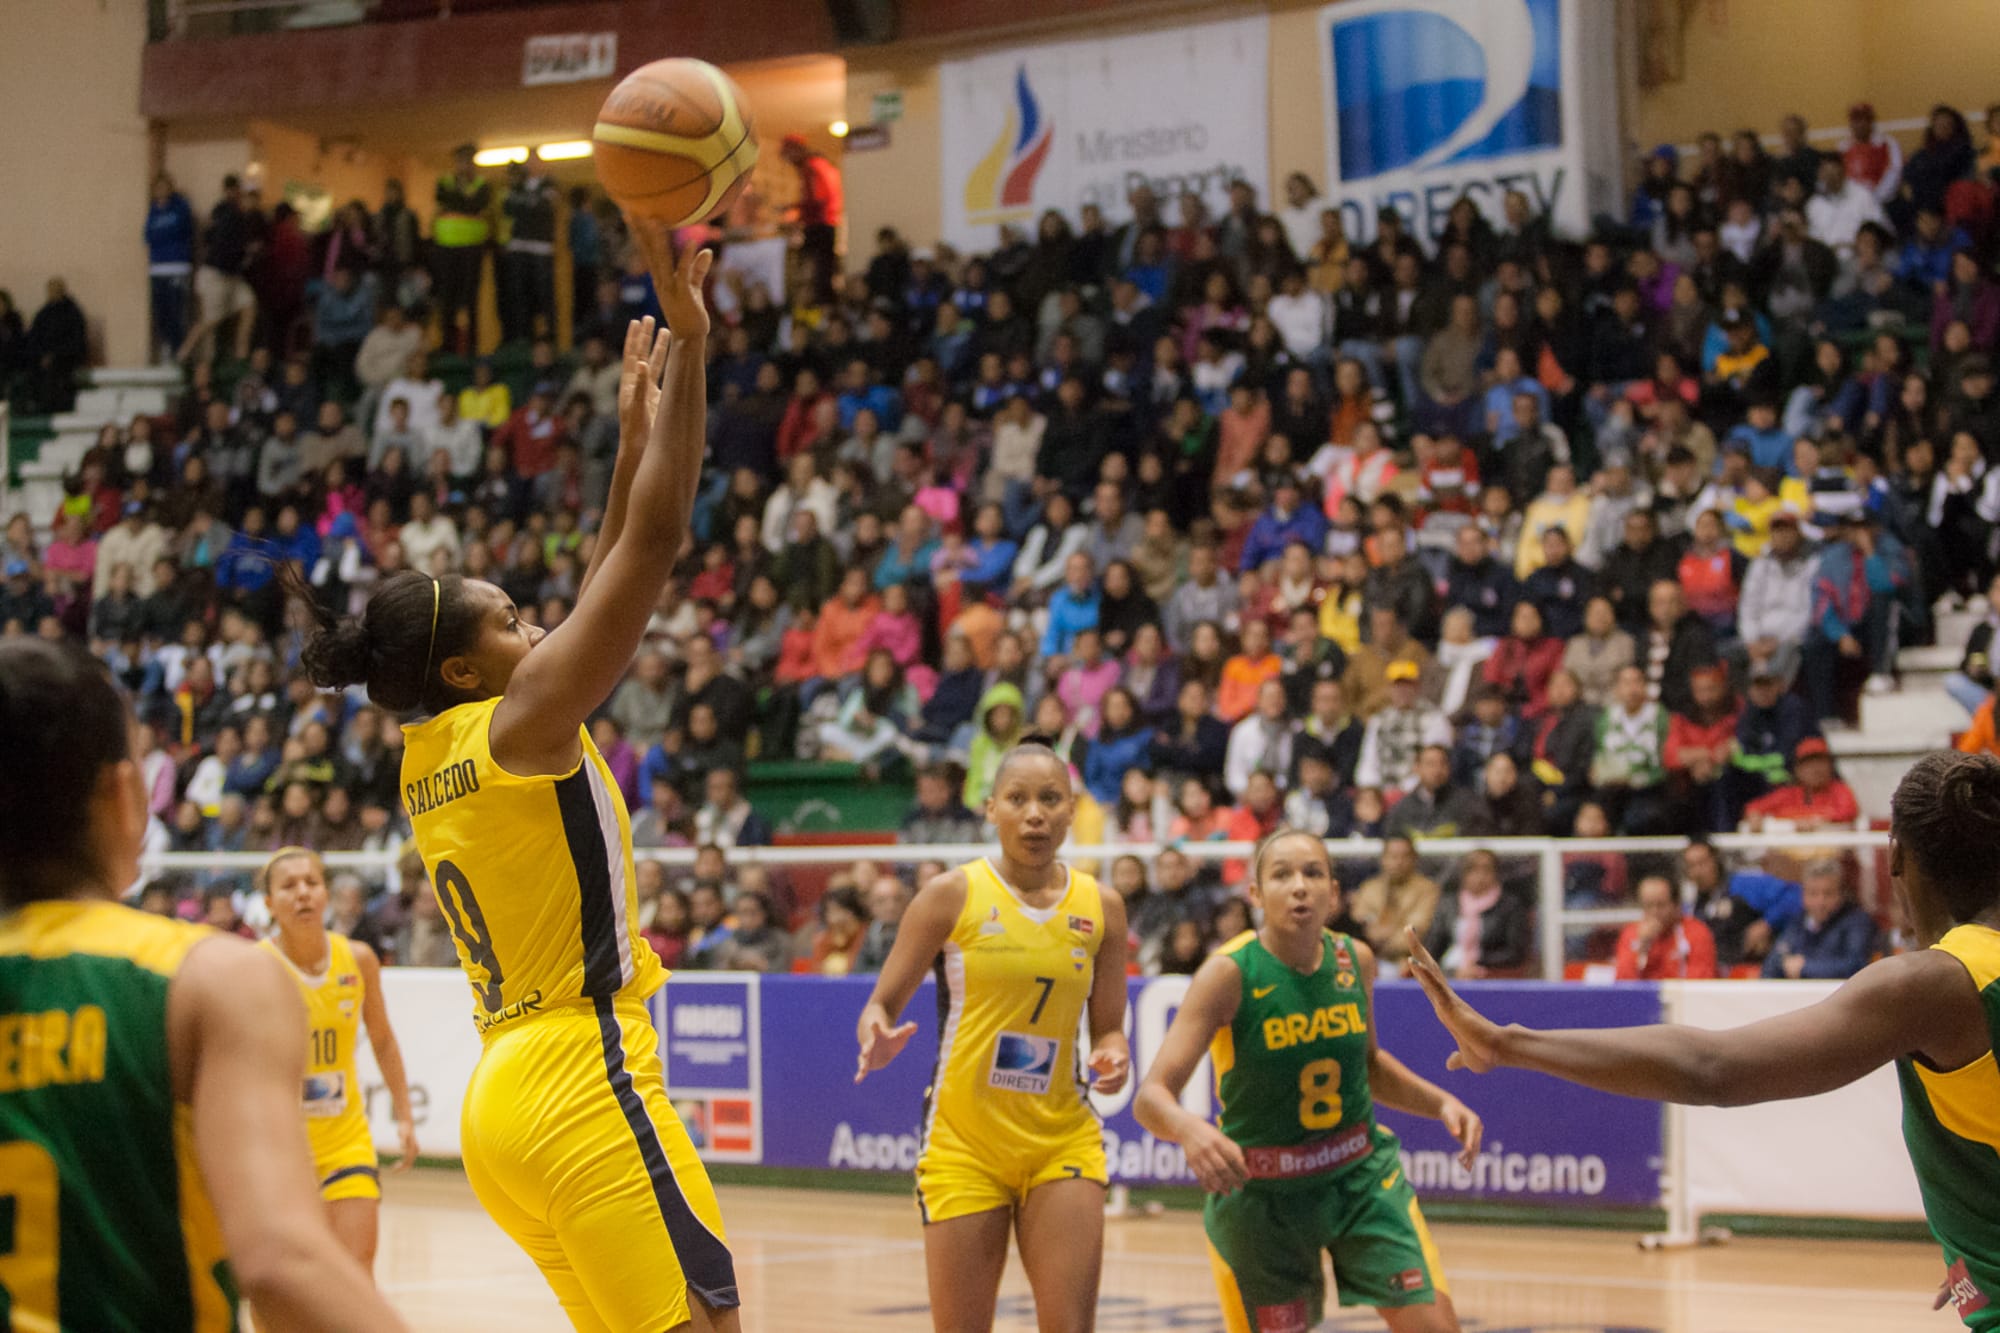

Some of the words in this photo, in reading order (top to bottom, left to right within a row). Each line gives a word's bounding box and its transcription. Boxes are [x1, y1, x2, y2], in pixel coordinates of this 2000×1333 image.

[406, 758, 481, 817] SALCEDO
[1029, 976, 1056, 1025] 7
[311, 1027, 338, 1066] 10
[1262, 1002, 1367, 1050] BRASIL
[1299, 1058, 1343, 1130] 8
[1279, 1130, 1368, 1174] Bradesco
